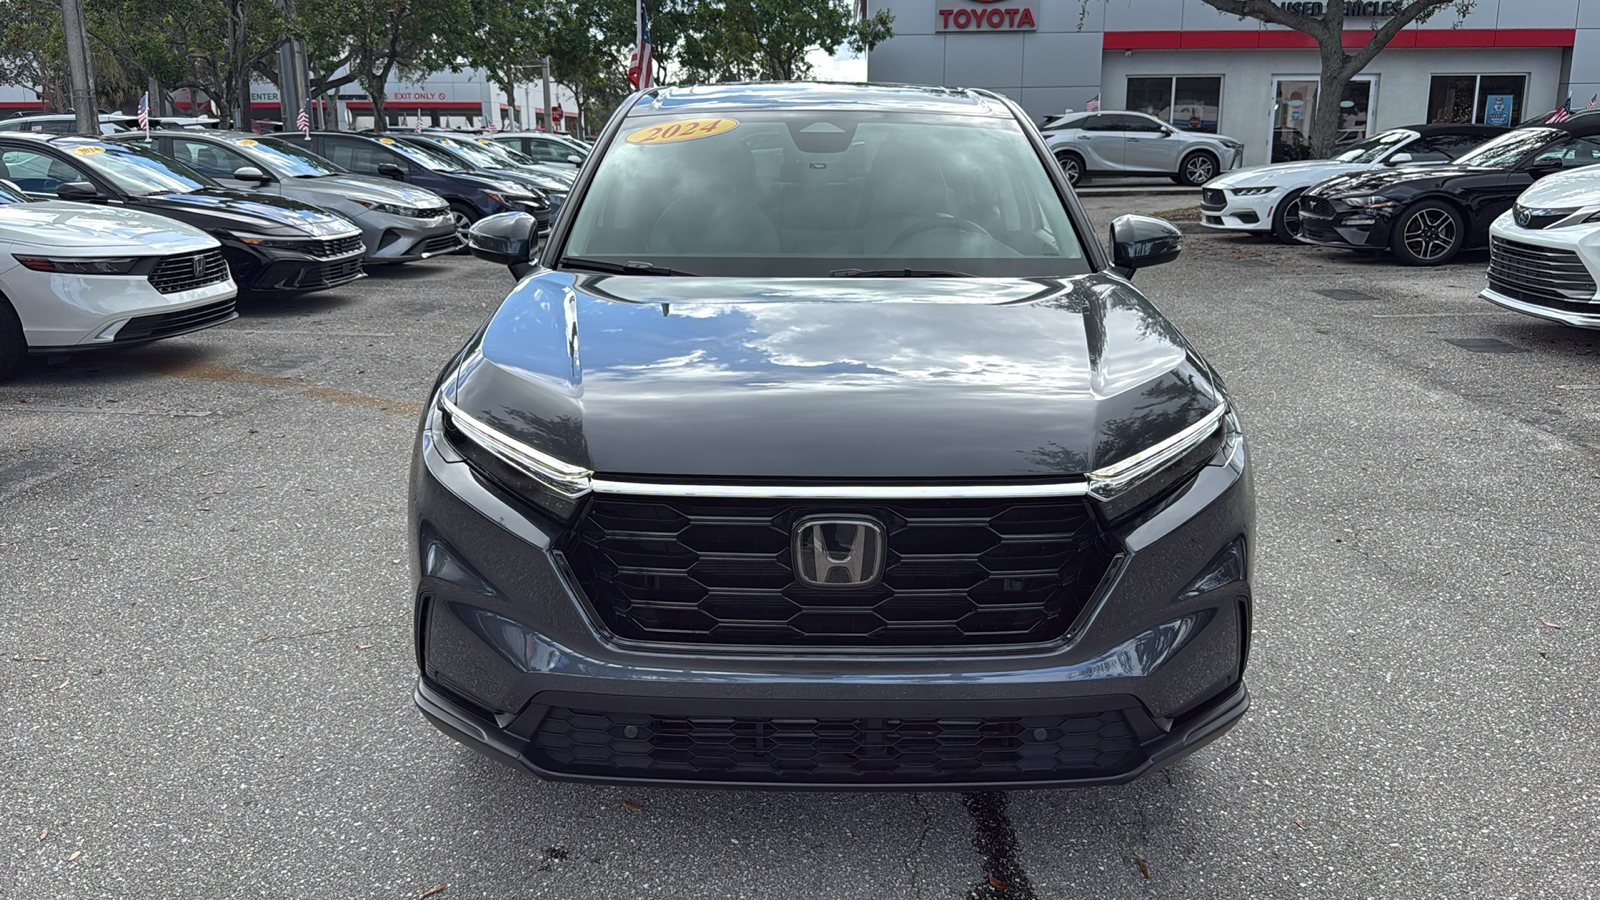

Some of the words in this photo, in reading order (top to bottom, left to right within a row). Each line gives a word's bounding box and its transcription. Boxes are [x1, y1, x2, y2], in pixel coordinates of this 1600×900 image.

[939, 8, 1035, 29] TOYOTA
[251, 92, 279, 101] ENTER
[394, 92, 411, 100] EXIT
[413, 92, 435, 100] ONLY
[637, 119, 722, 143] 2024
